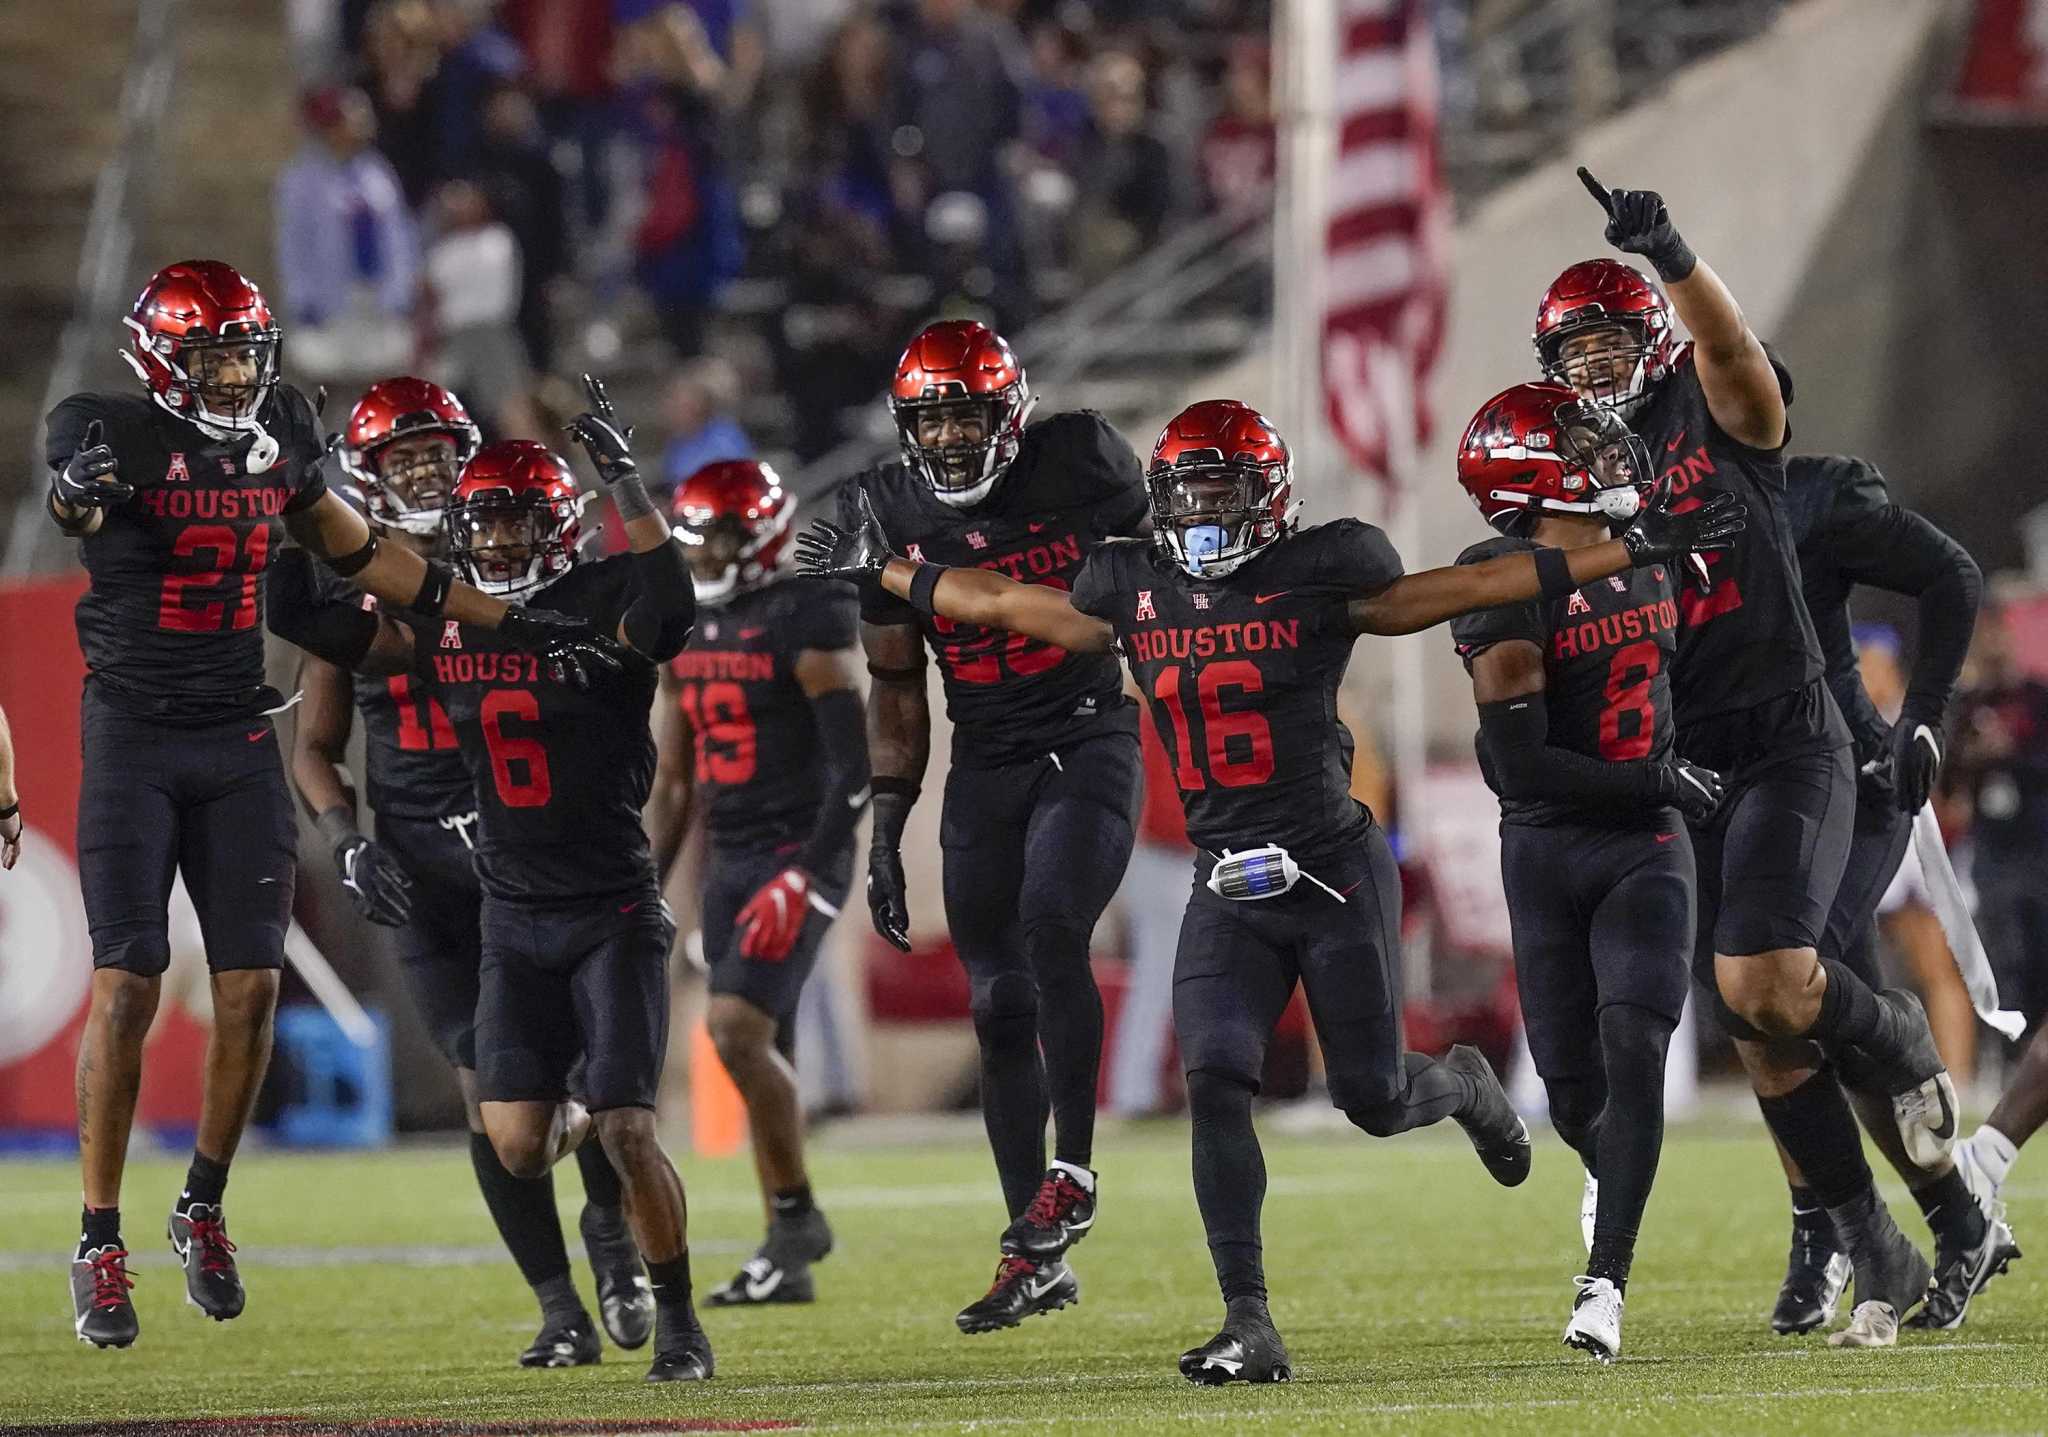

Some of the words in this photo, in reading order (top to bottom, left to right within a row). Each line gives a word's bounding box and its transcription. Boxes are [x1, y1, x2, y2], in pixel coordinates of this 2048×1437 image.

[159, 522, 270, 633] 21
[1554, 599, 1678, 660] HOUSTON
[1131, 619, 1299, 662] HOUSTON
[480, 689, 552, 807] 6
[681, 681, 757, 784] 19
[1155, 659, 1276, 790] 16
[1600, 639, 1661, 762] 8
